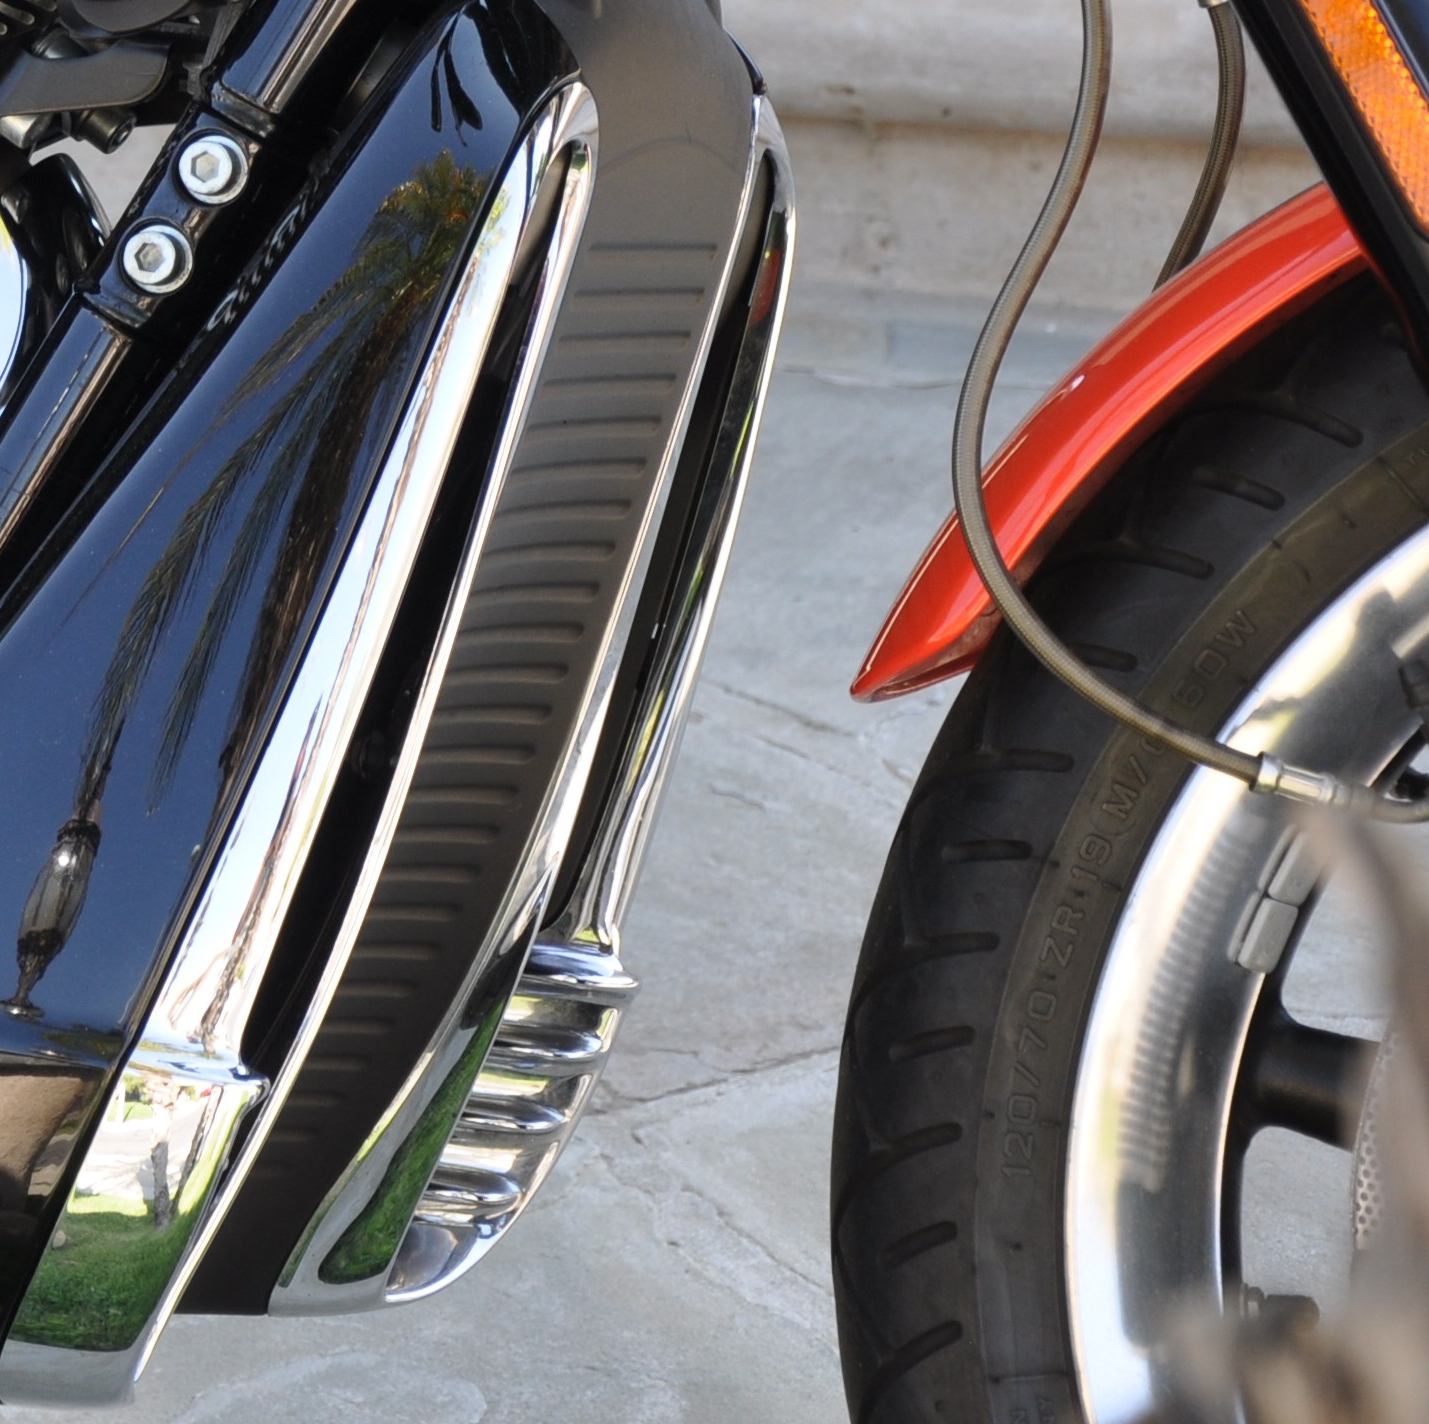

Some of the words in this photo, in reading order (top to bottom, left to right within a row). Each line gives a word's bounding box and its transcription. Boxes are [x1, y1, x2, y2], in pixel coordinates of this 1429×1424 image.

[1001, 988, 1058, 1177] 120/70
[1039, 903, 1085, 968] ZR
[1071, 833, 1113, 881] 19
[1171, 610, 1258, 709] 60W
